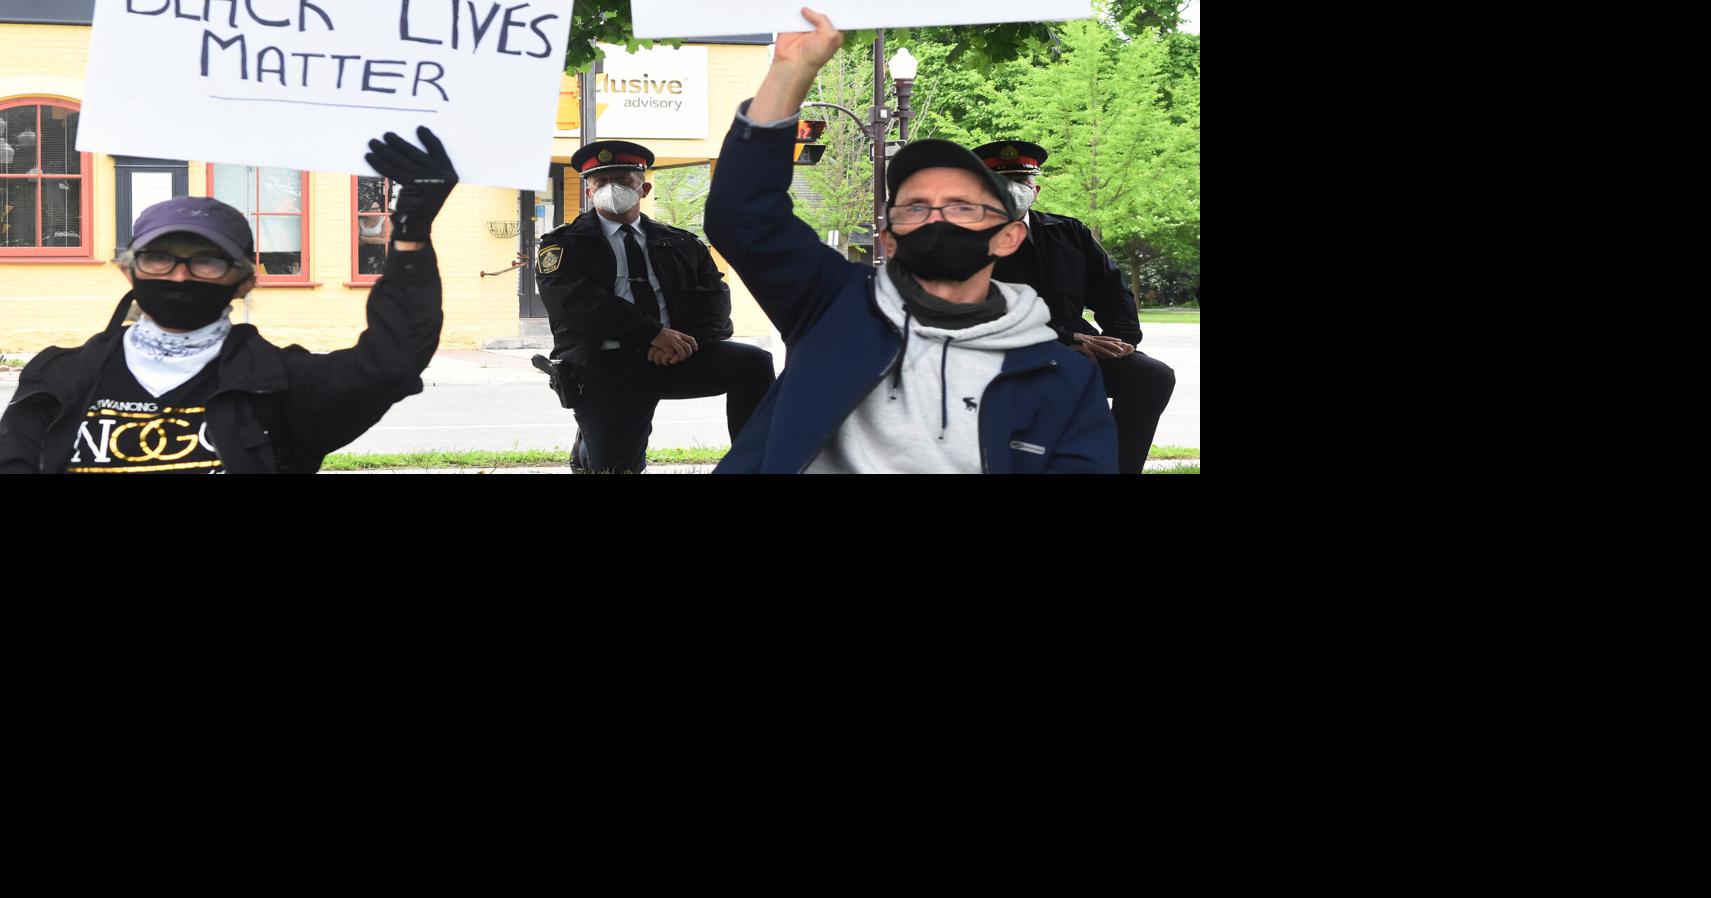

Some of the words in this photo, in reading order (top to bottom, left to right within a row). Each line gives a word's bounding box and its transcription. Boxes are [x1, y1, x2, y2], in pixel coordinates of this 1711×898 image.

[400, 0, 559, 58] LIVES
[200, 29, 449, 102] MATTER
[624, 97, 683, 112] advisory
